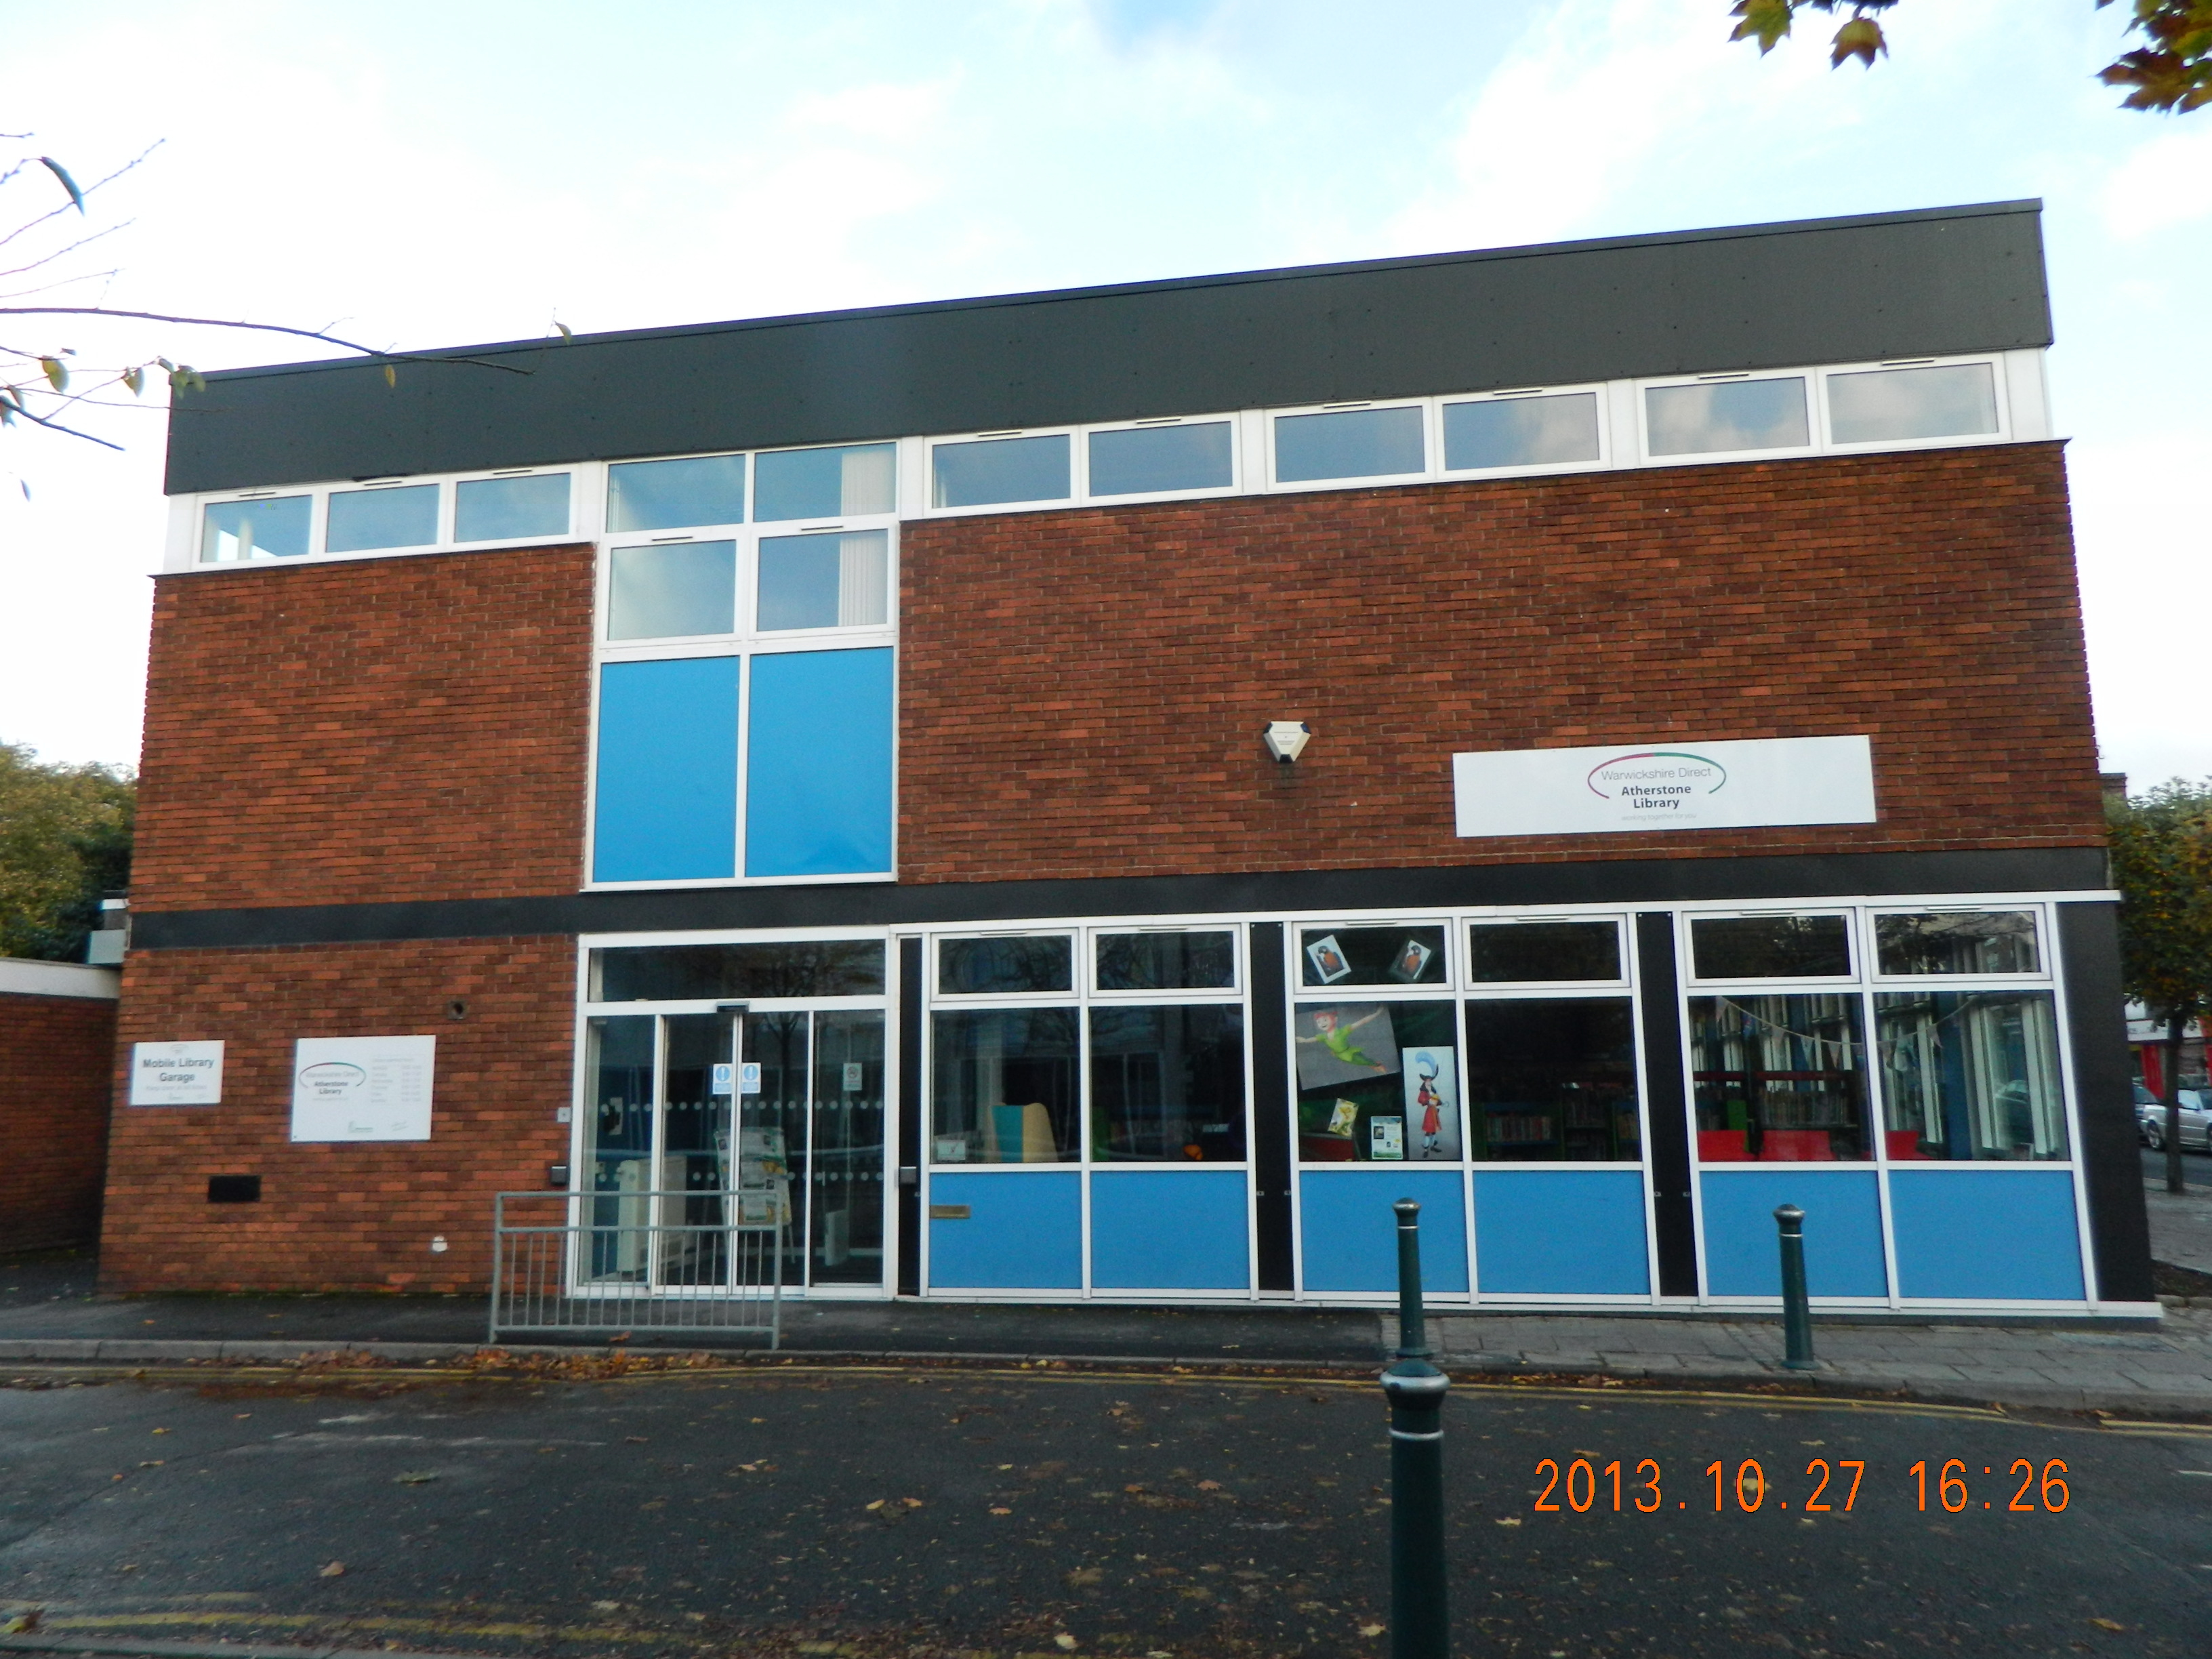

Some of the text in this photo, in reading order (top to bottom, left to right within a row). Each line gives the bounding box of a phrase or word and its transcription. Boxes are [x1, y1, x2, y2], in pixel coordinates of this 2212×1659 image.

[1601, 766, 1712, 781] Warwickshire Direct
[1621, 785, 1692, 796] Atherstone
[1633, 798, 1680, 810] Library
[1647, 813, 1674, 821] together
[143, 1058, 214, 1069] Mobile Library
[159, 1072, 196, 1084] Garage
